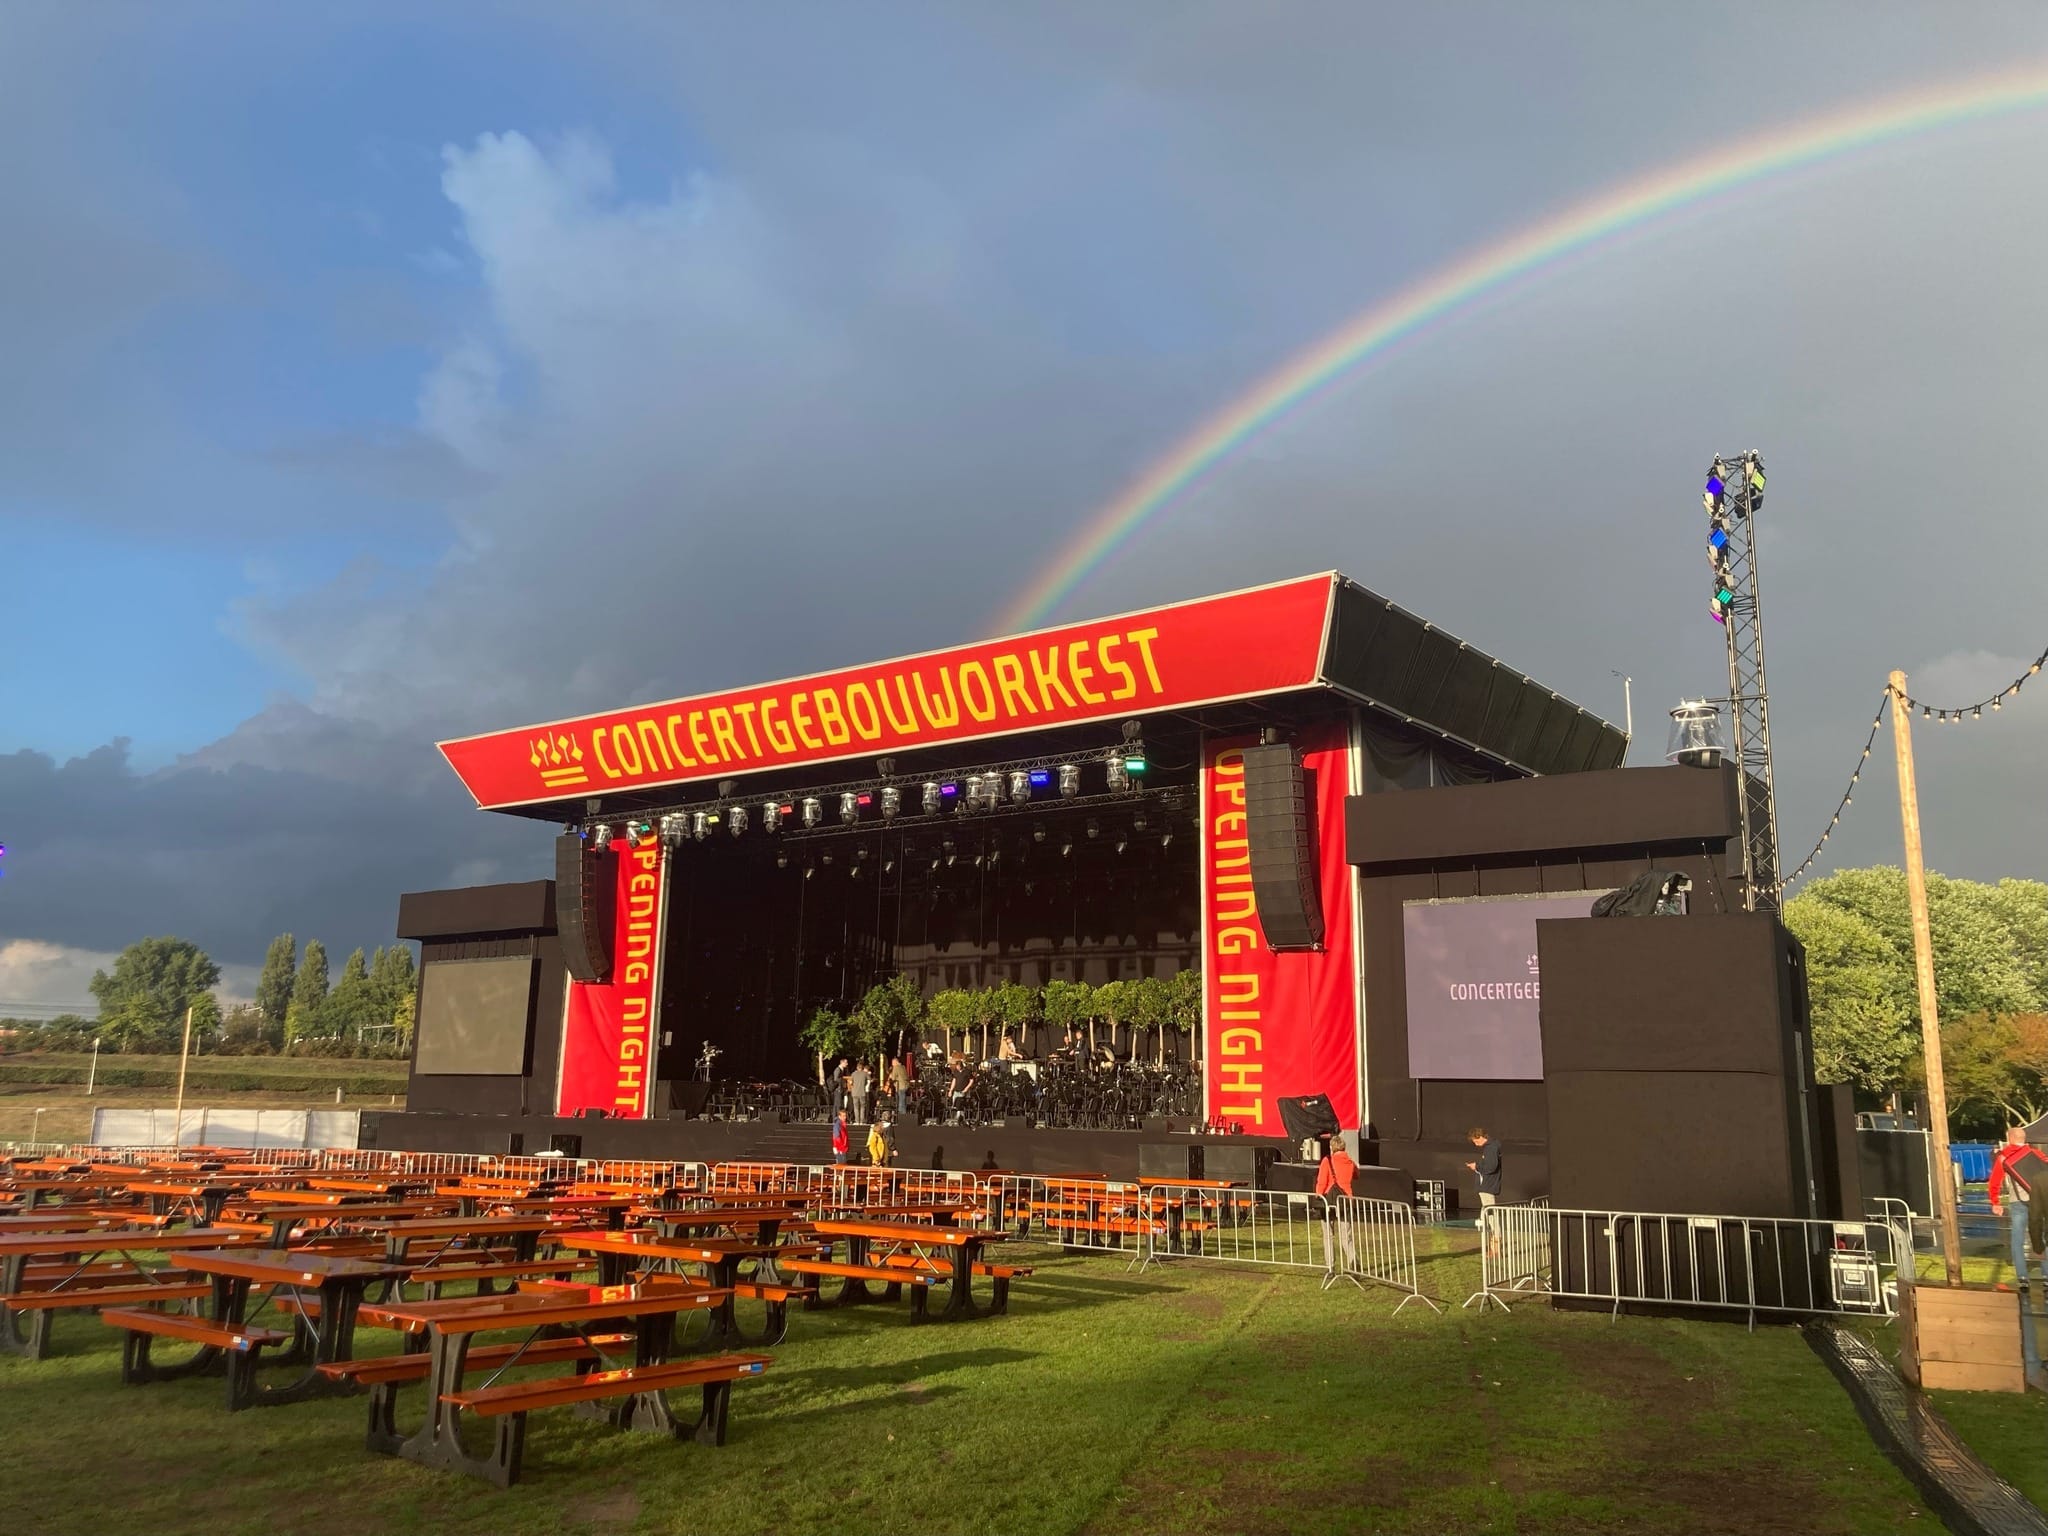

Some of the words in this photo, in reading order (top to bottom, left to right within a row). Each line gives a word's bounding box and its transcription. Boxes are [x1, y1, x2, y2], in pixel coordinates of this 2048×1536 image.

[593, 628, 1163, 778] CONCERTGEBOUWORKEST
[1215, 749, 1257, 954] OPENING
[615, 998, 647, 1112] NIGHT
[1220, 974, 1262, 1124] NIGHT
